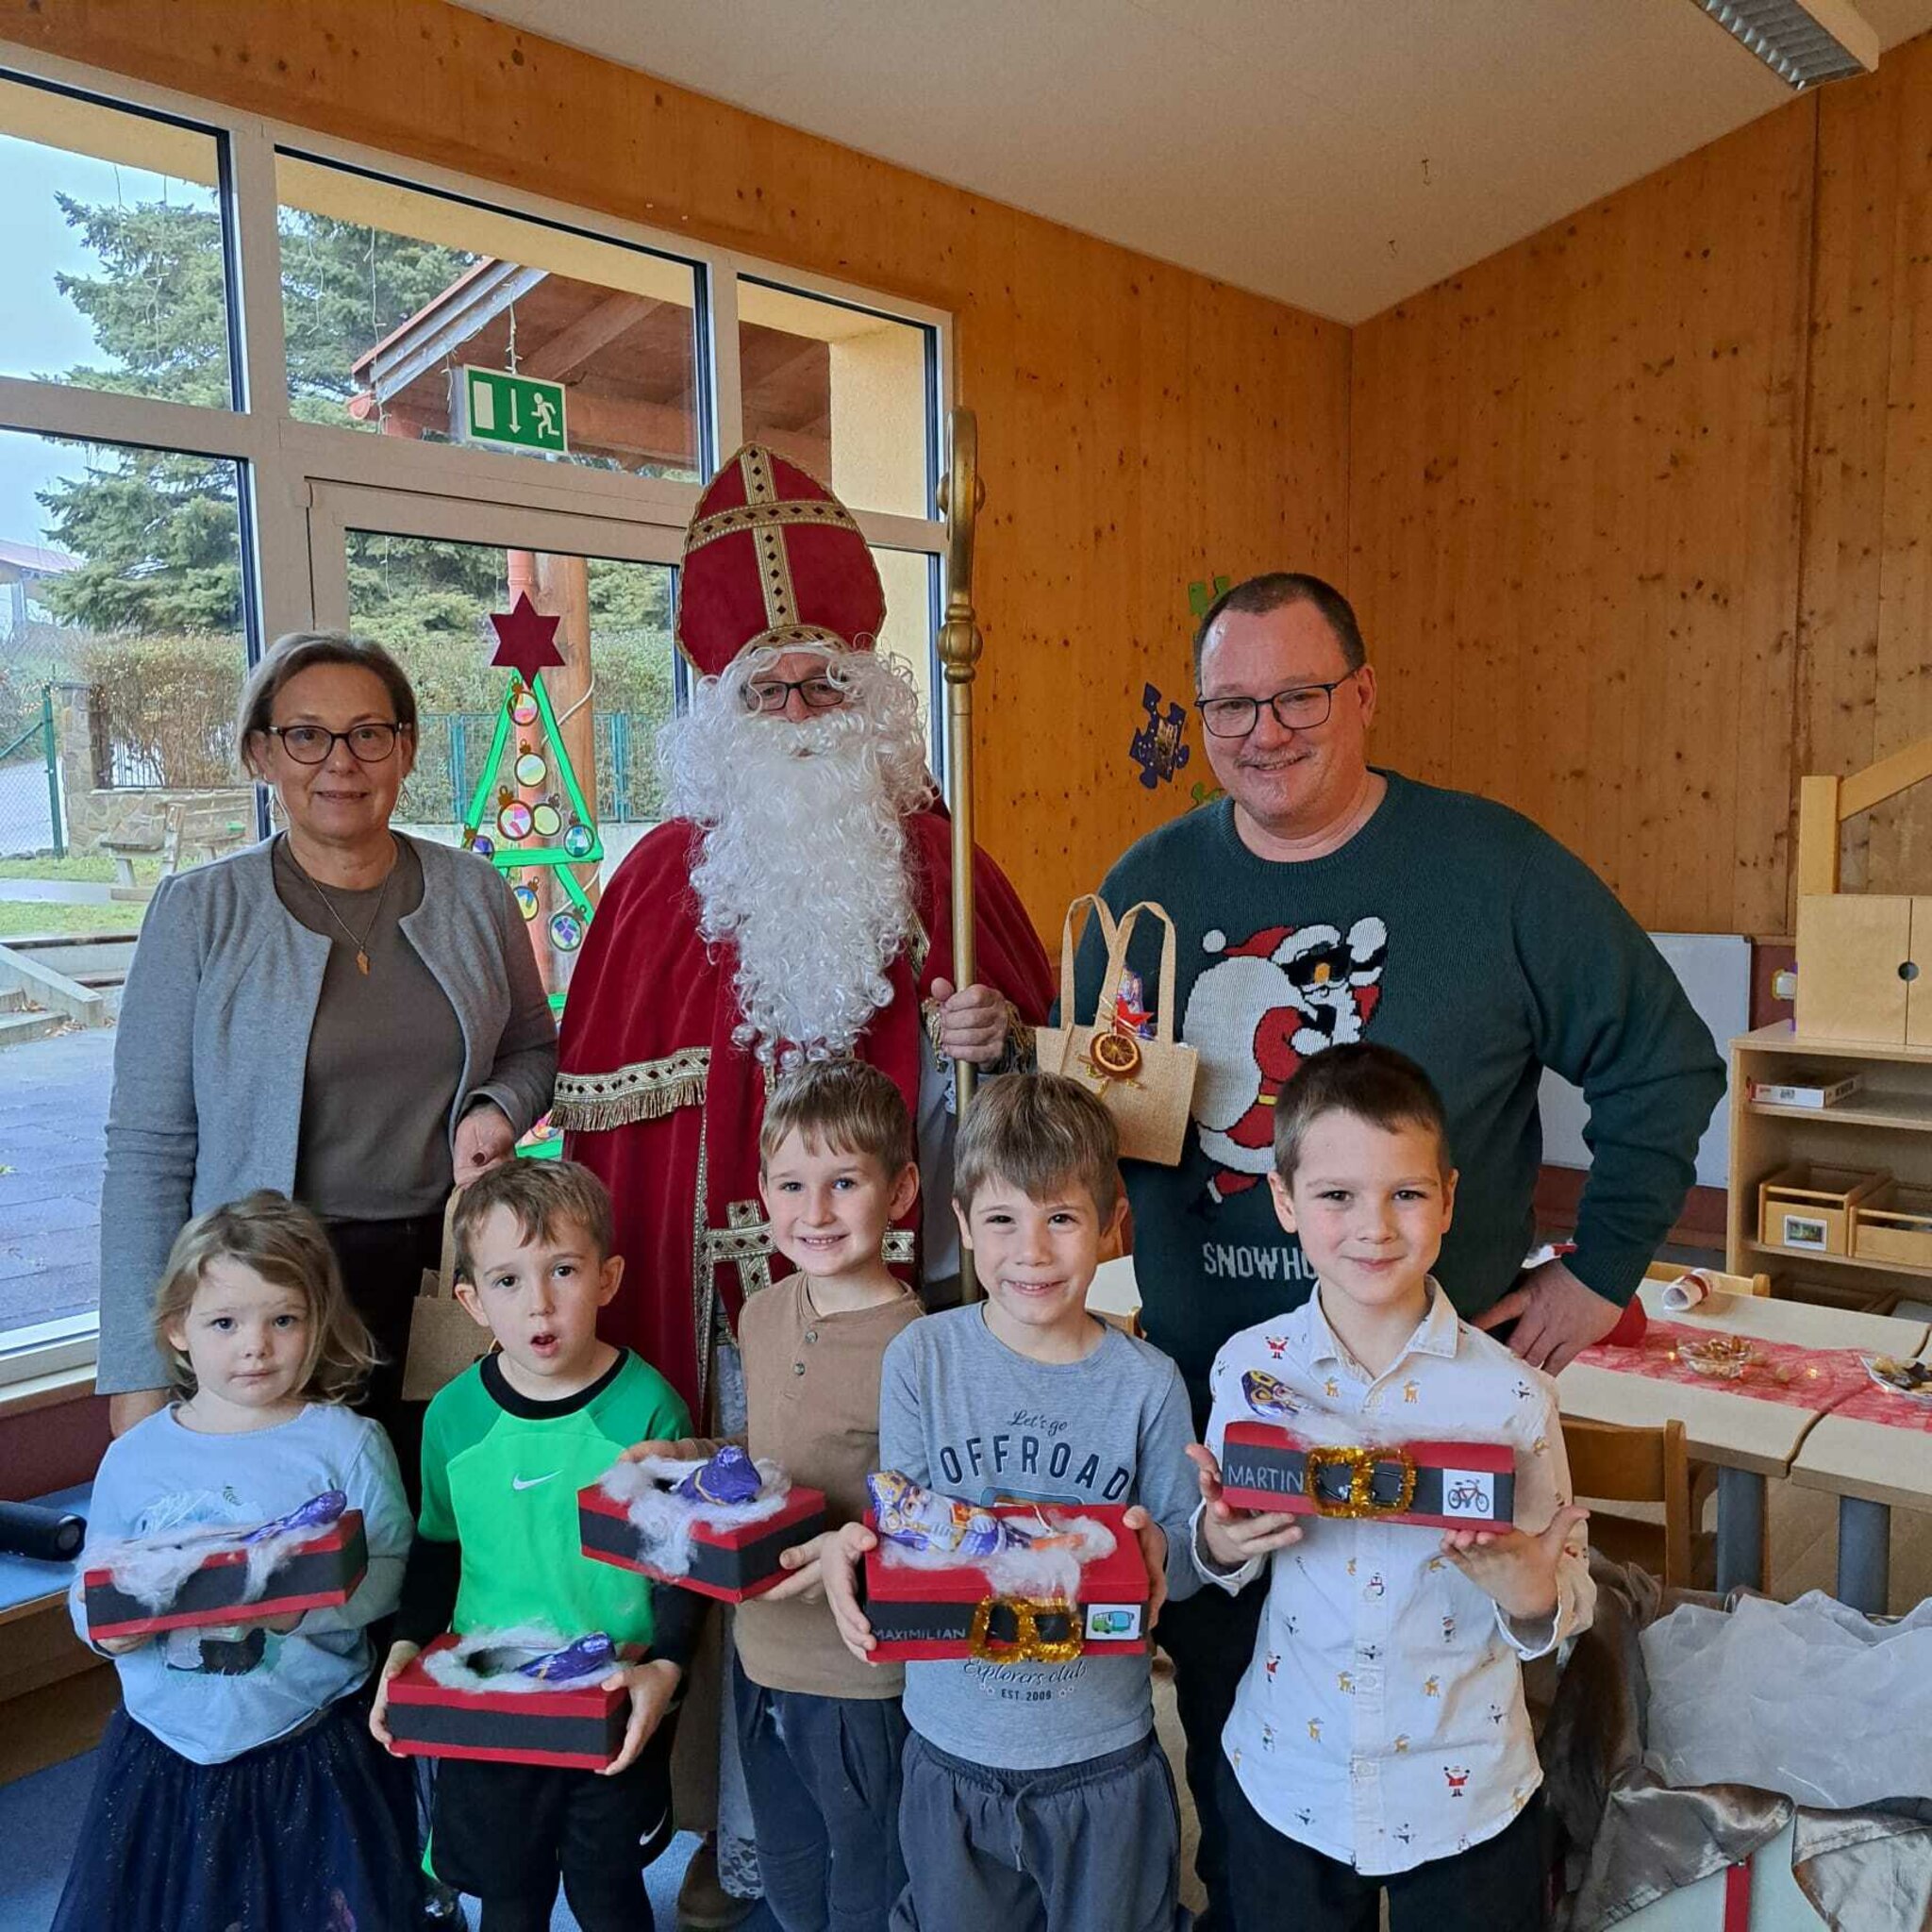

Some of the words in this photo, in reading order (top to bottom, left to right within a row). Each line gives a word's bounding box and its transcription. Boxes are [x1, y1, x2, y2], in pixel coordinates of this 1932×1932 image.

[1007, 1409, 1046, 1429] Let's
[1047, 1421, 1068, 1438] go
[940, 1434, 1130, 1501] OFFROAD
[1227, 1465, 1304, 1492] MARTIN
[873, 1628, 966, 1641] MAXIMILIAN
[1048, 1660, 1088, 1683] club
